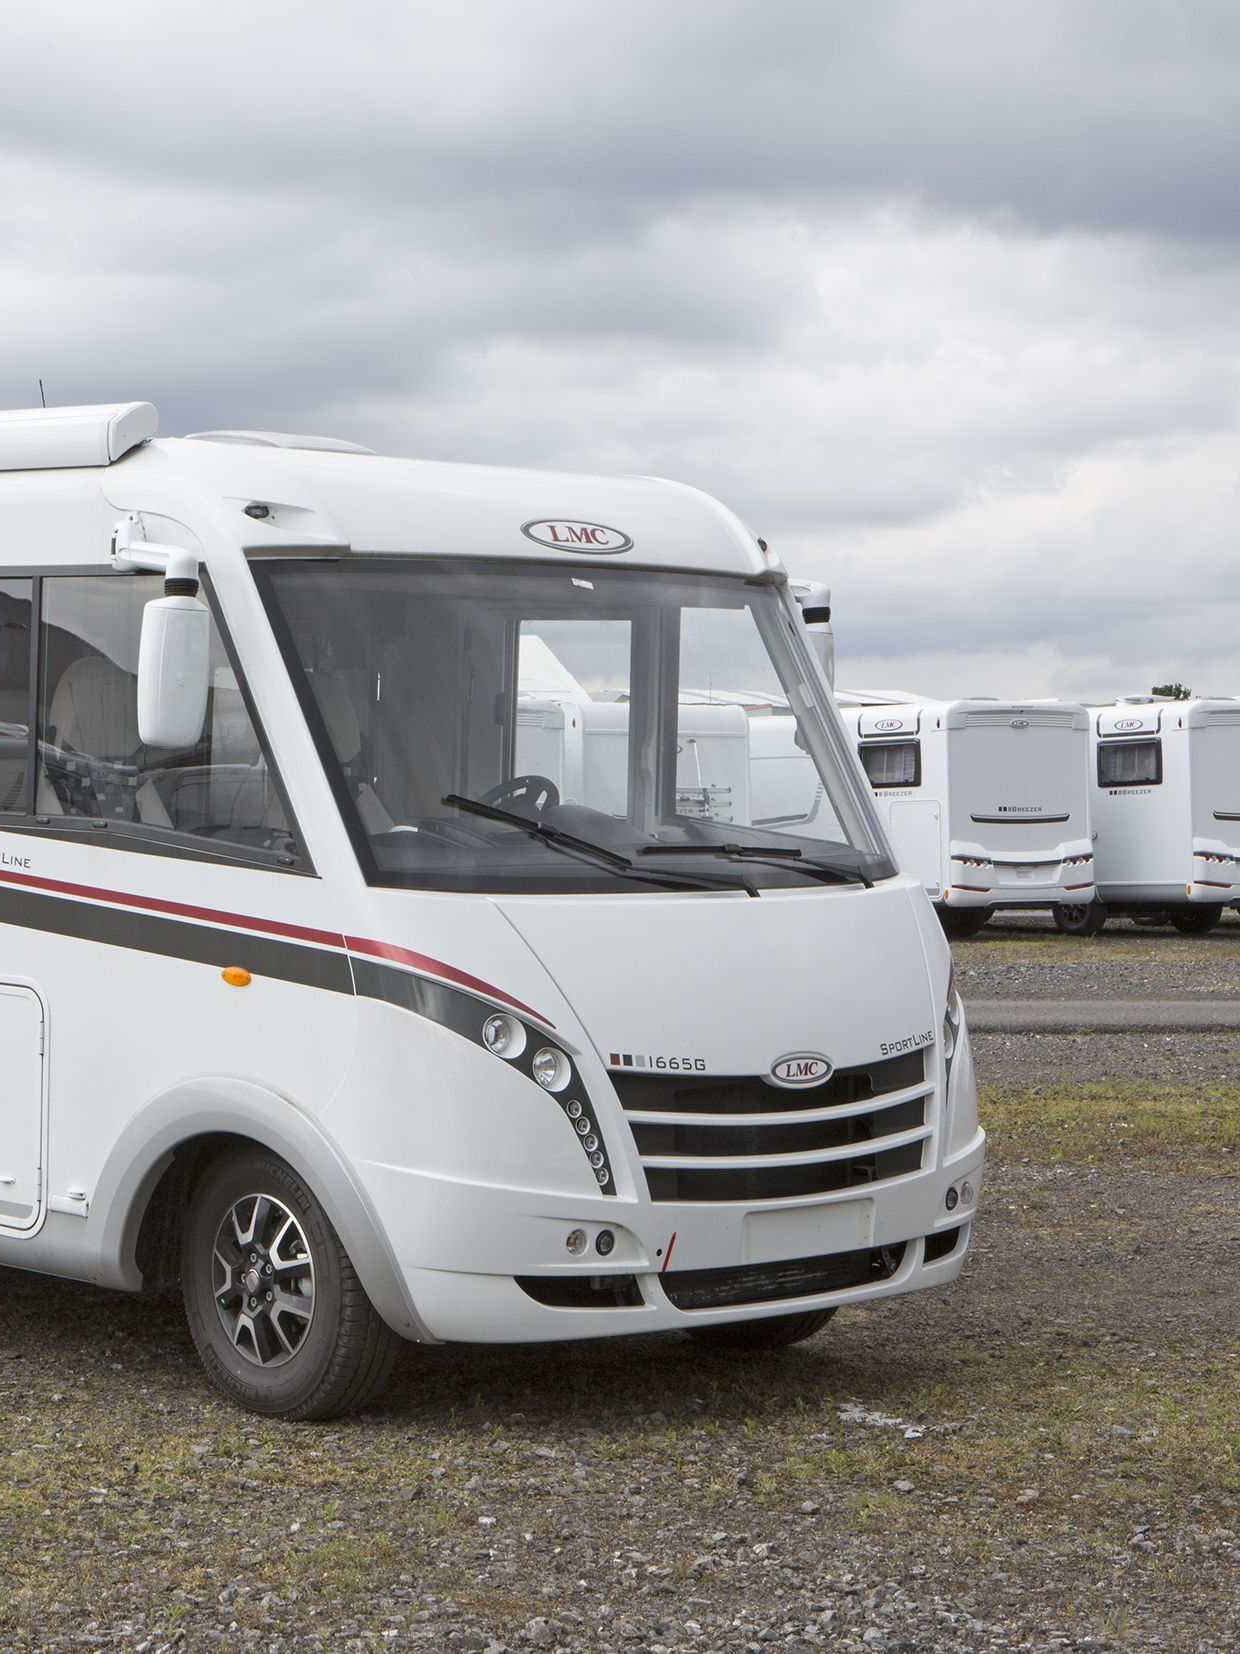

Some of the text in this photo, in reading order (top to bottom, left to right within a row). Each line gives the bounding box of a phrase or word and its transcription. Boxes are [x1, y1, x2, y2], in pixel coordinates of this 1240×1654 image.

[546, 524, 610, 545] LMC
[785, 1061, 819, 1078] LMC
[251, 1160, 312, 1213] MICHELIN
